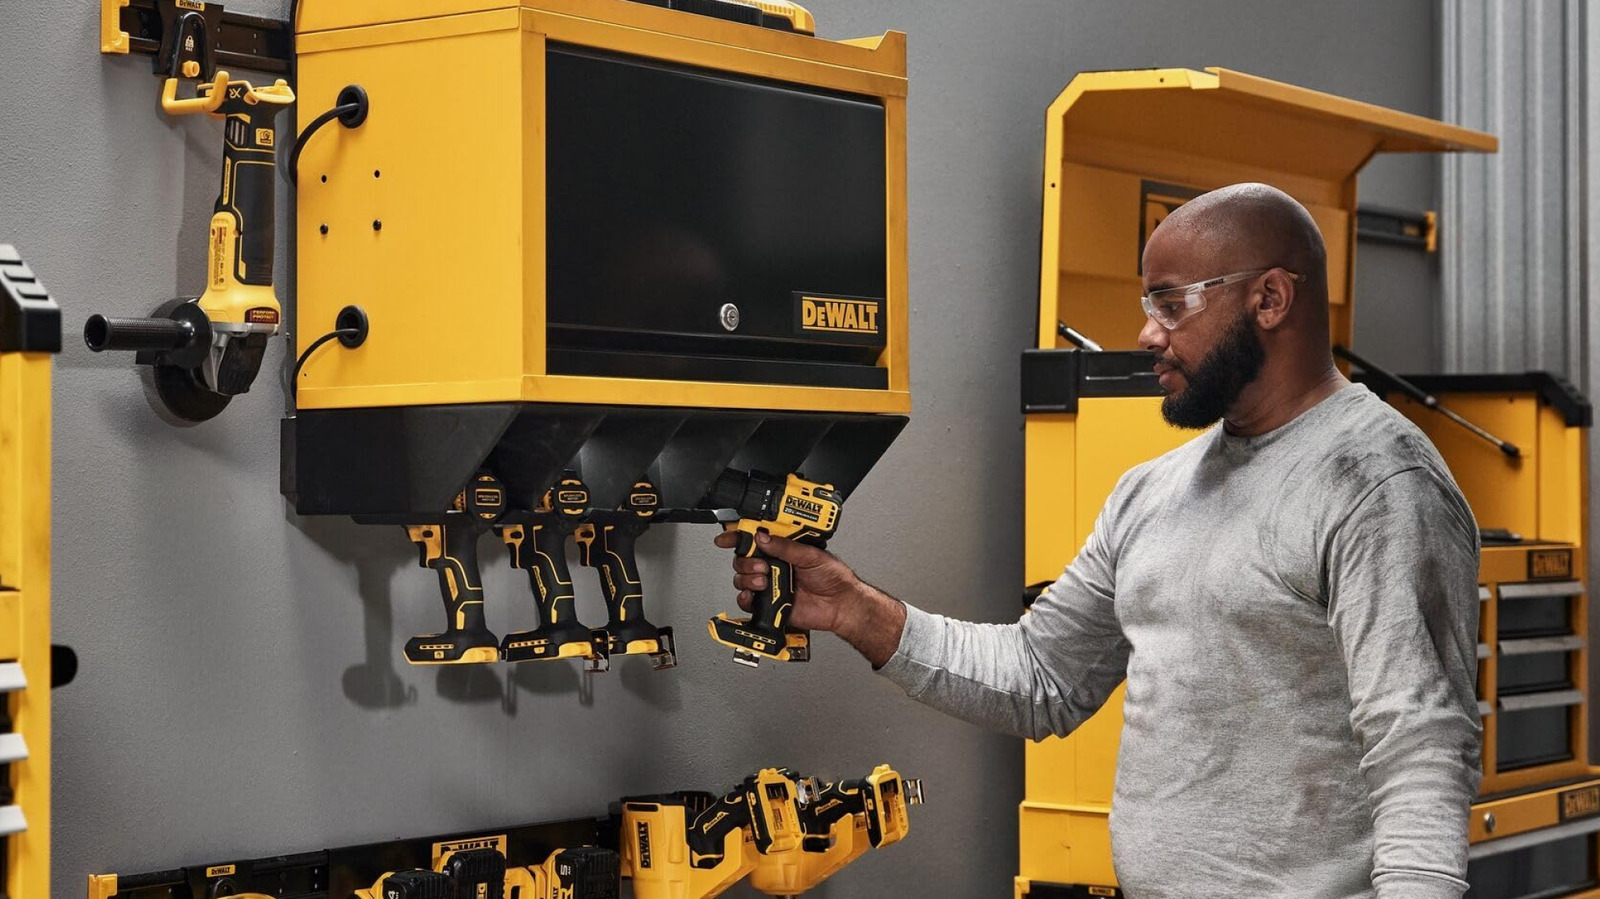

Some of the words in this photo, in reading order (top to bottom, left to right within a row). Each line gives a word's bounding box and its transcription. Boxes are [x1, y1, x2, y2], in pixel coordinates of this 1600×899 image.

[802, 299, 878, 331] DEWALT
[785, 496, 823, 515] DEWALT
[637, 822, 651, 868] DEWALT
